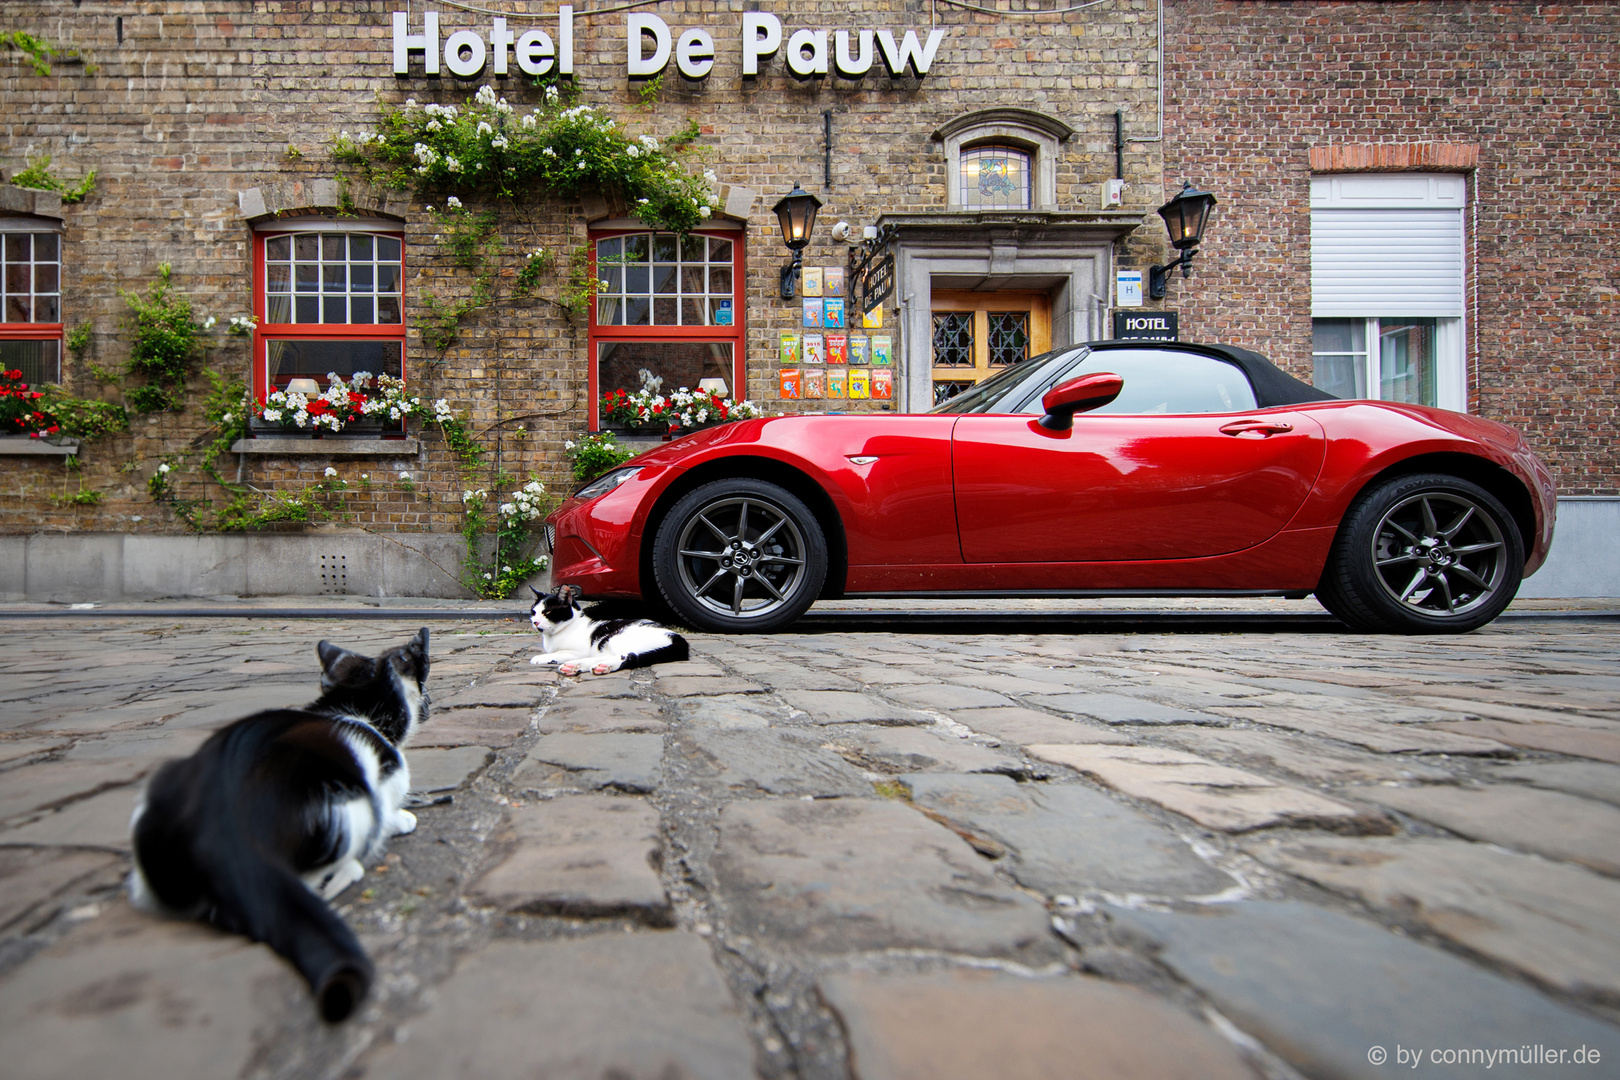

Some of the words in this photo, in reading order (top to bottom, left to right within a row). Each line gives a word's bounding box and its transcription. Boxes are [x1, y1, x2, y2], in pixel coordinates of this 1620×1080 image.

[392, 5, 573, 77] Hotel
[627, 12, 715, 78] De
[743, 12, 945, 77] Pauw
[868, 264, 888, 290] HOTEL
[1126, 285, 1133, 294] H
[865, 292, 873, 308] DE
[874, 274, 892, 300] PAUW
[1126, 317, 1170, 330] HOTEL
